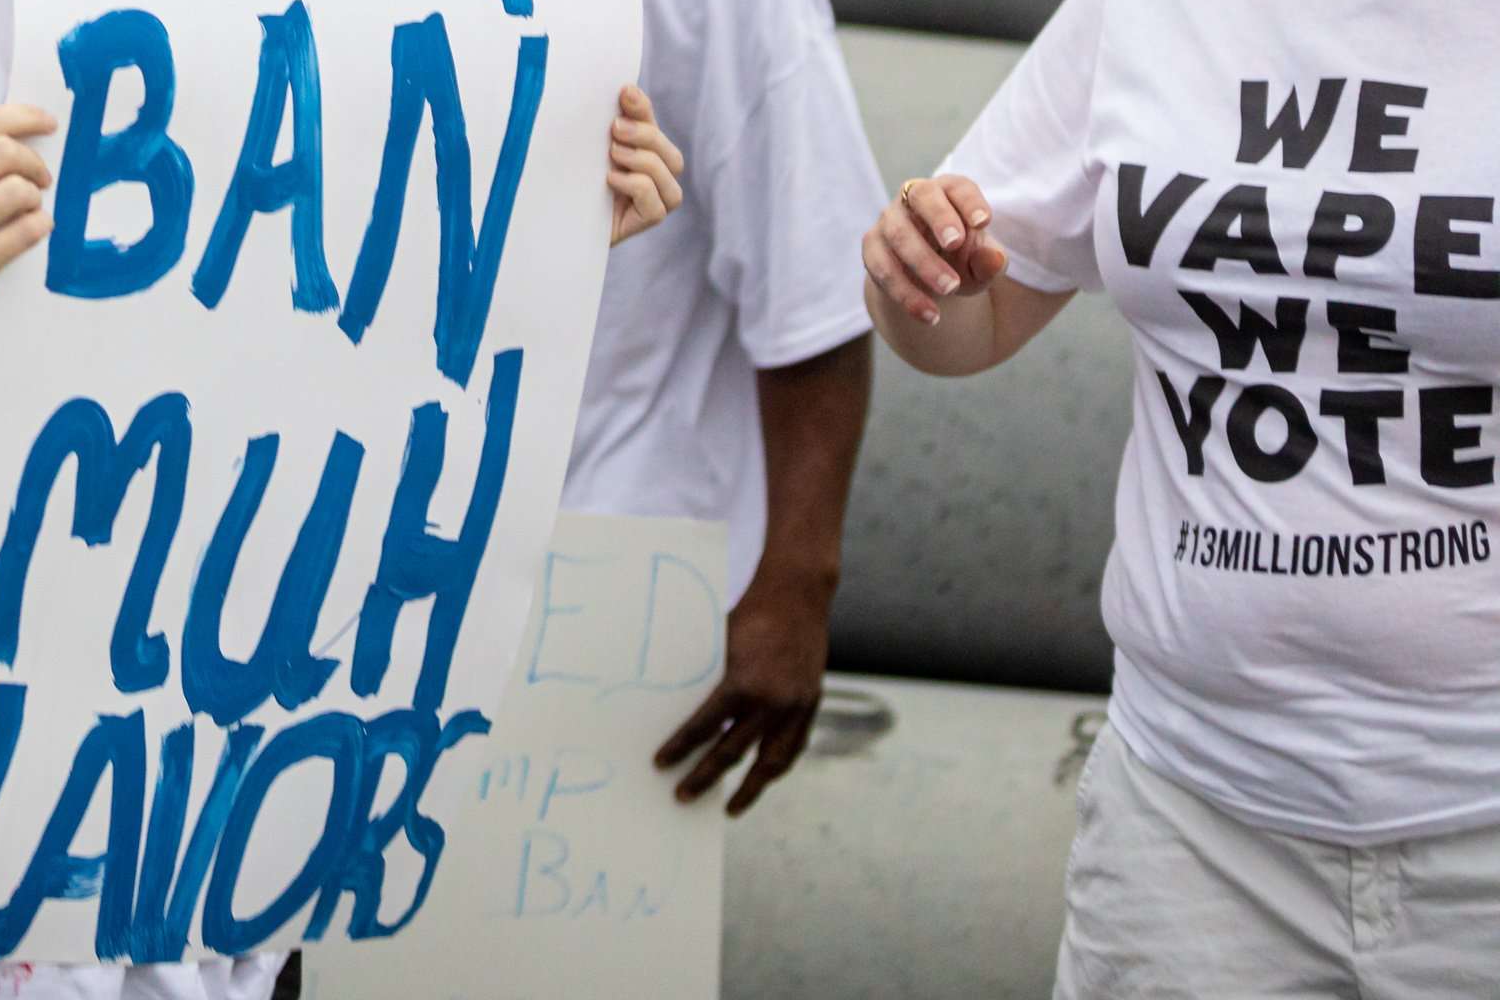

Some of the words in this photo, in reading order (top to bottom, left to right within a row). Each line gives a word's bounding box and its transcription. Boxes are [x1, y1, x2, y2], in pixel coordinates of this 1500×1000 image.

[1236, 78, 1428, 173] WE
[1117, 162, 1500, 301] VAPE
[1176, 289, 1413, 375] WE
[1155, 369, 1497, 489] VOTE
[1174, 519, 1492, 578] #13MILLIONSTRONG
